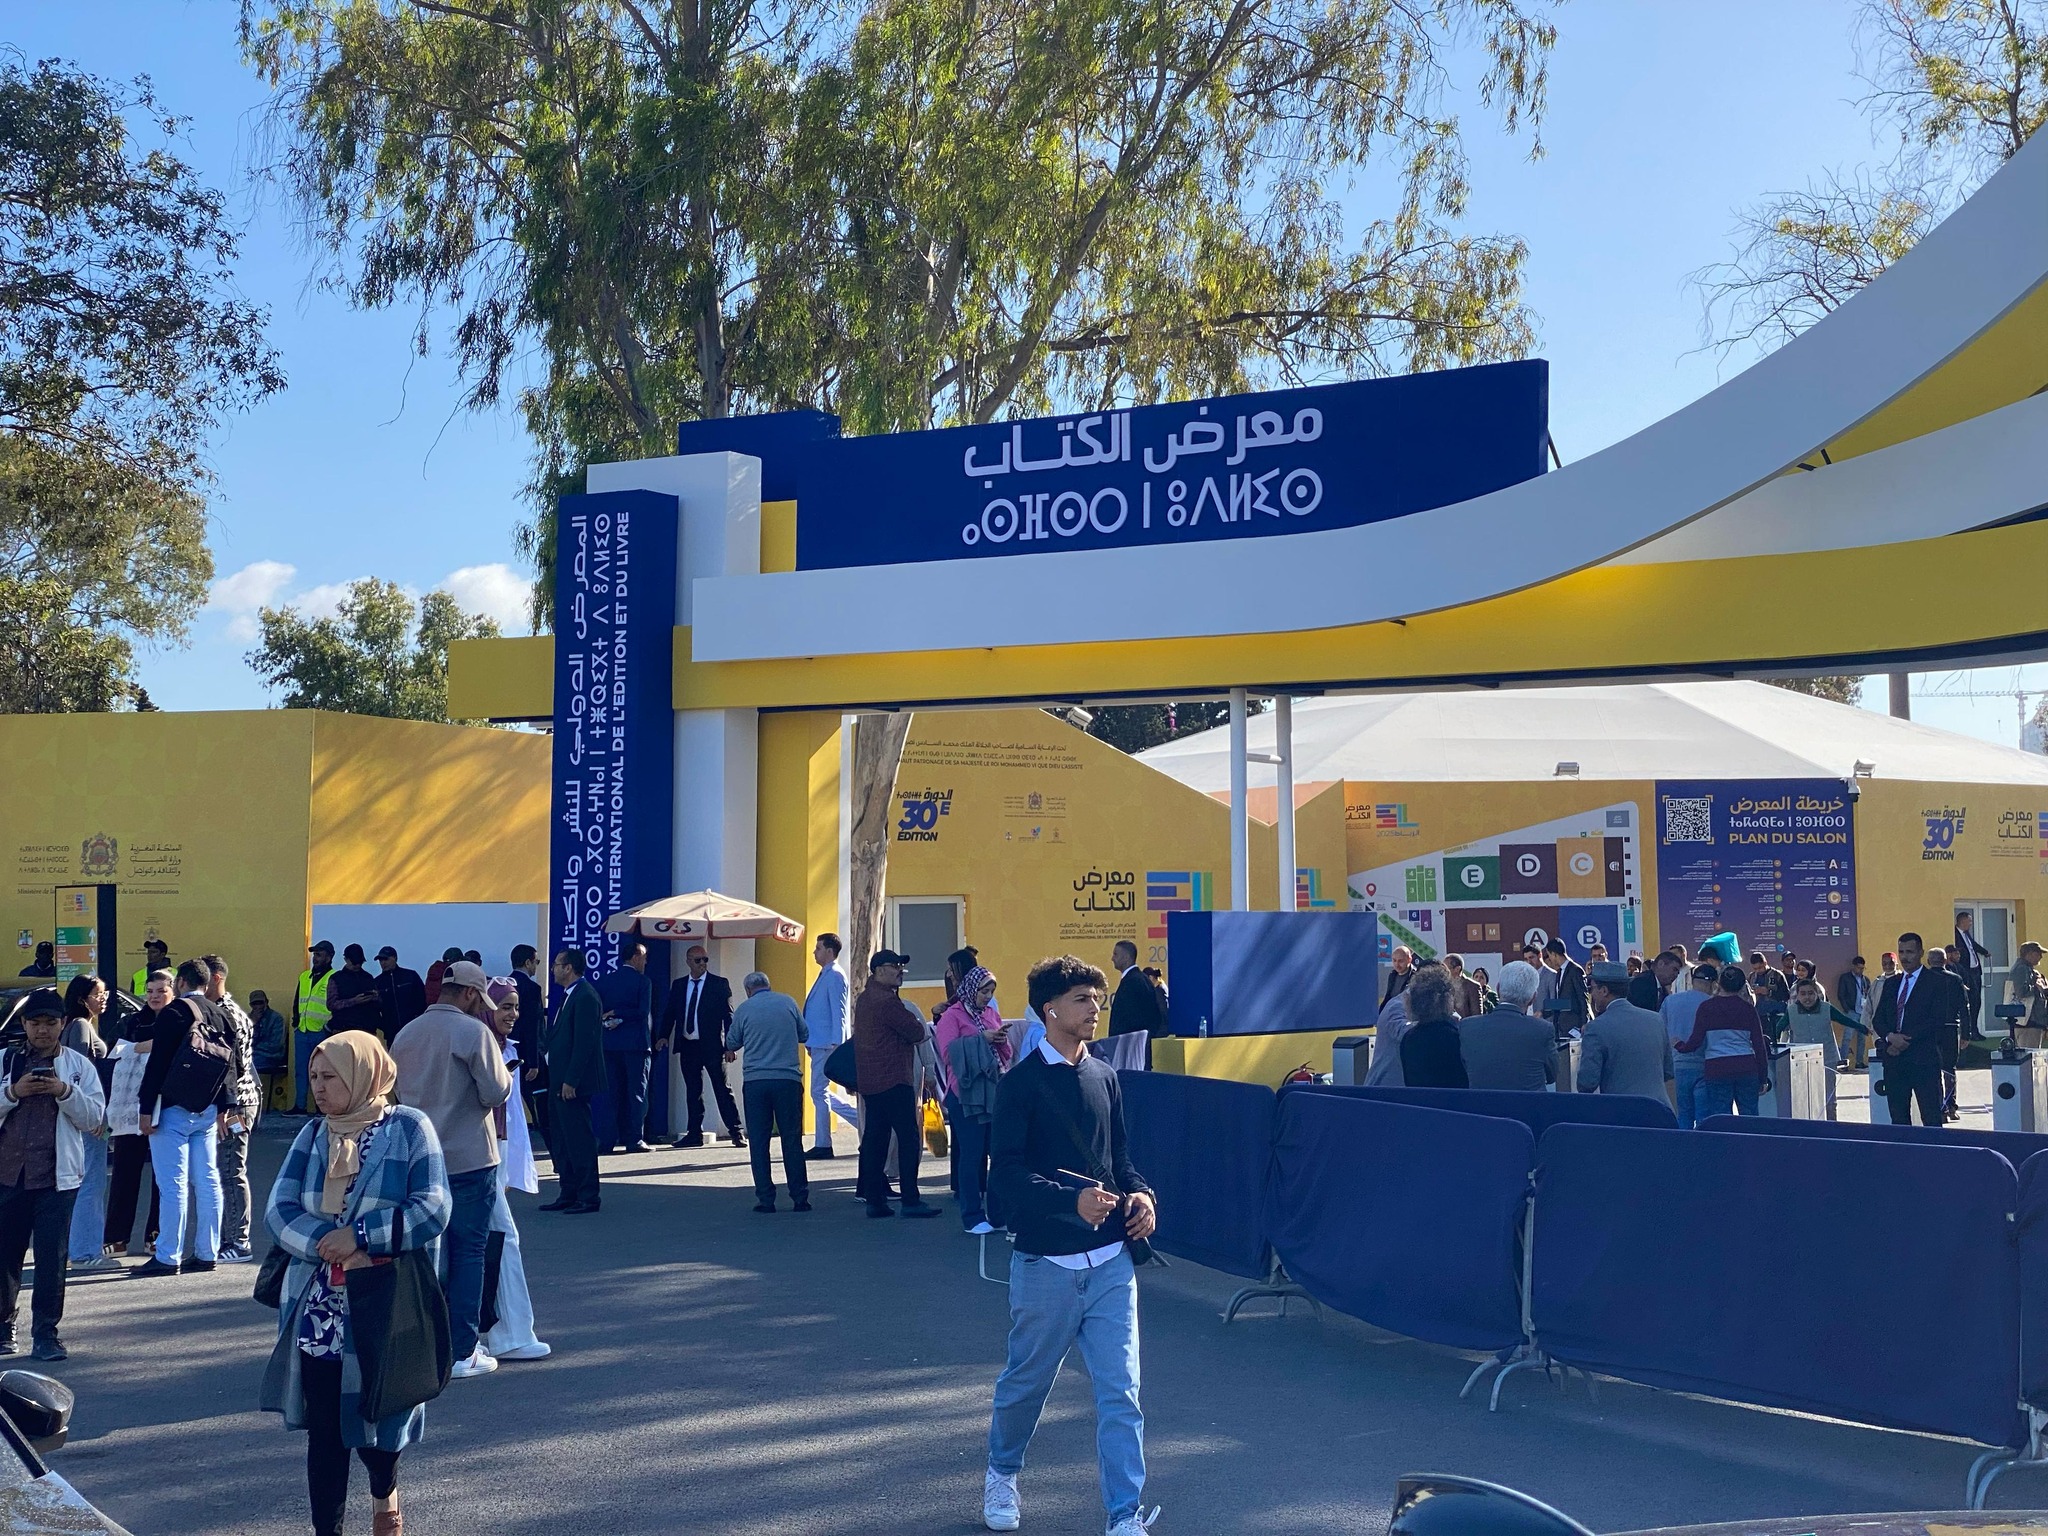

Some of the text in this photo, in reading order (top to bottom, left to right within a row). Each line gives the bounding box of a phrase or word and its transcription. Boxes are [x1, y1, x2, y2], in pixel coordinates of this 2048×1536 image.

[964, 406, 1324, 489] معرض الكتاب
[616, 512, 630, 565] LIVRE
[570, 515, 589, 640] المعرض
[615, 570, 629, 596] DU
[615, 602, 628, 624] ET
[568, 654, 586, 766] الدولي
[612, 726, 625, 751] DE
[924, 787, 954, 803] الدورة
[562, 780, 583, 841] للنشر
[1730, 796, 1844, 814] خريطة المعرض
[1942, 805, 1966, 821] الدورة
[1998, 808, 2032, 824] معرض
[608, 756, 624, 910] INTERNATIONAL
[1729, 832, 1846, 844] PLAN DU SALON
[1998, 824, 2033, 842] الكتاب
[1522, 858, 1536, 873] D
[1574, 858, 1588, 871] C
[1829, 858, 1838, 869] A
[1073, 866, 1135, 891] معرض
[1467, 869, 1480, 884] E
[1830, 876, 1838, 886] B
[1074, 891, 1135, 917] الكتاب
[1830, 892, 1838, 902] C
[1831, 910, 1840, 919] D
[654, 920, 692, 934] G4S
[1832, 926, 1840, 936] E
[1530, 930, 1545, 946] A
[1582, 930, 1597, 944] B
